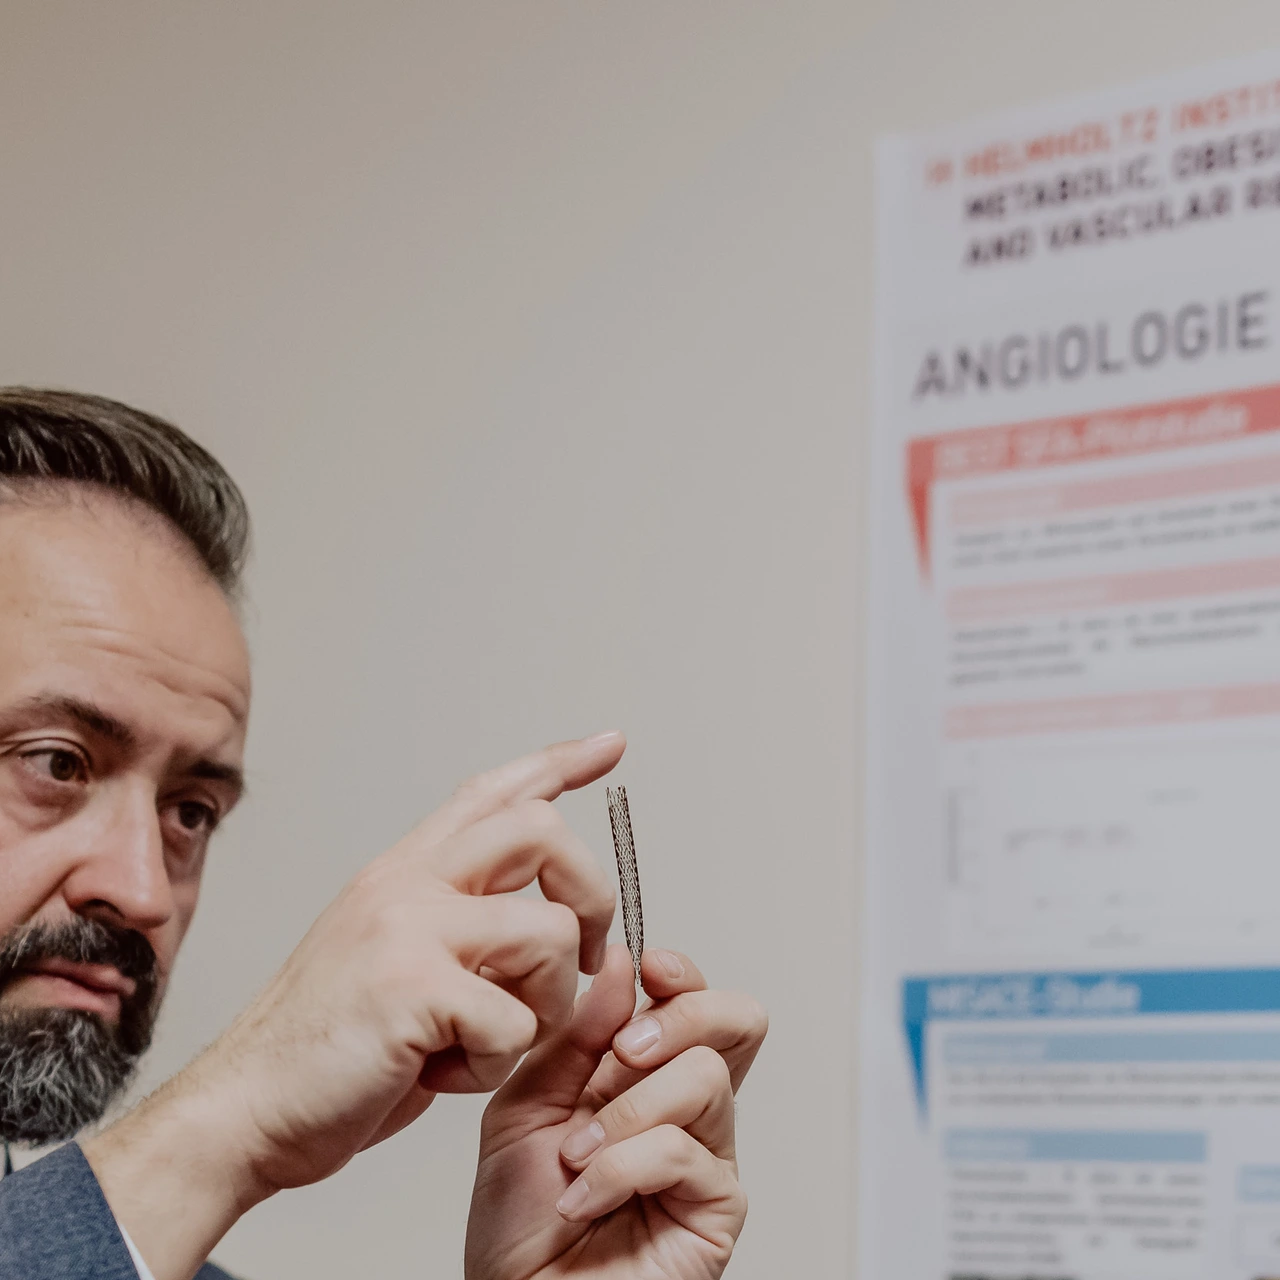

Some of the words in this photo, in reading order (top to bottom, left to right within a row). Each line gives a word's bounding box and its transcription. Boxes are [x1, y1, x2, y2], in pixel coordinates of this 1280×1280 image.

[963, 104, 1160, 180] HELMHOLTZ
[964, 227, 1035, 268] AND
[1045, 186, 1234, 253] VASCULAR
[911, 289, 1271, 402] ANGIOLOGIE
